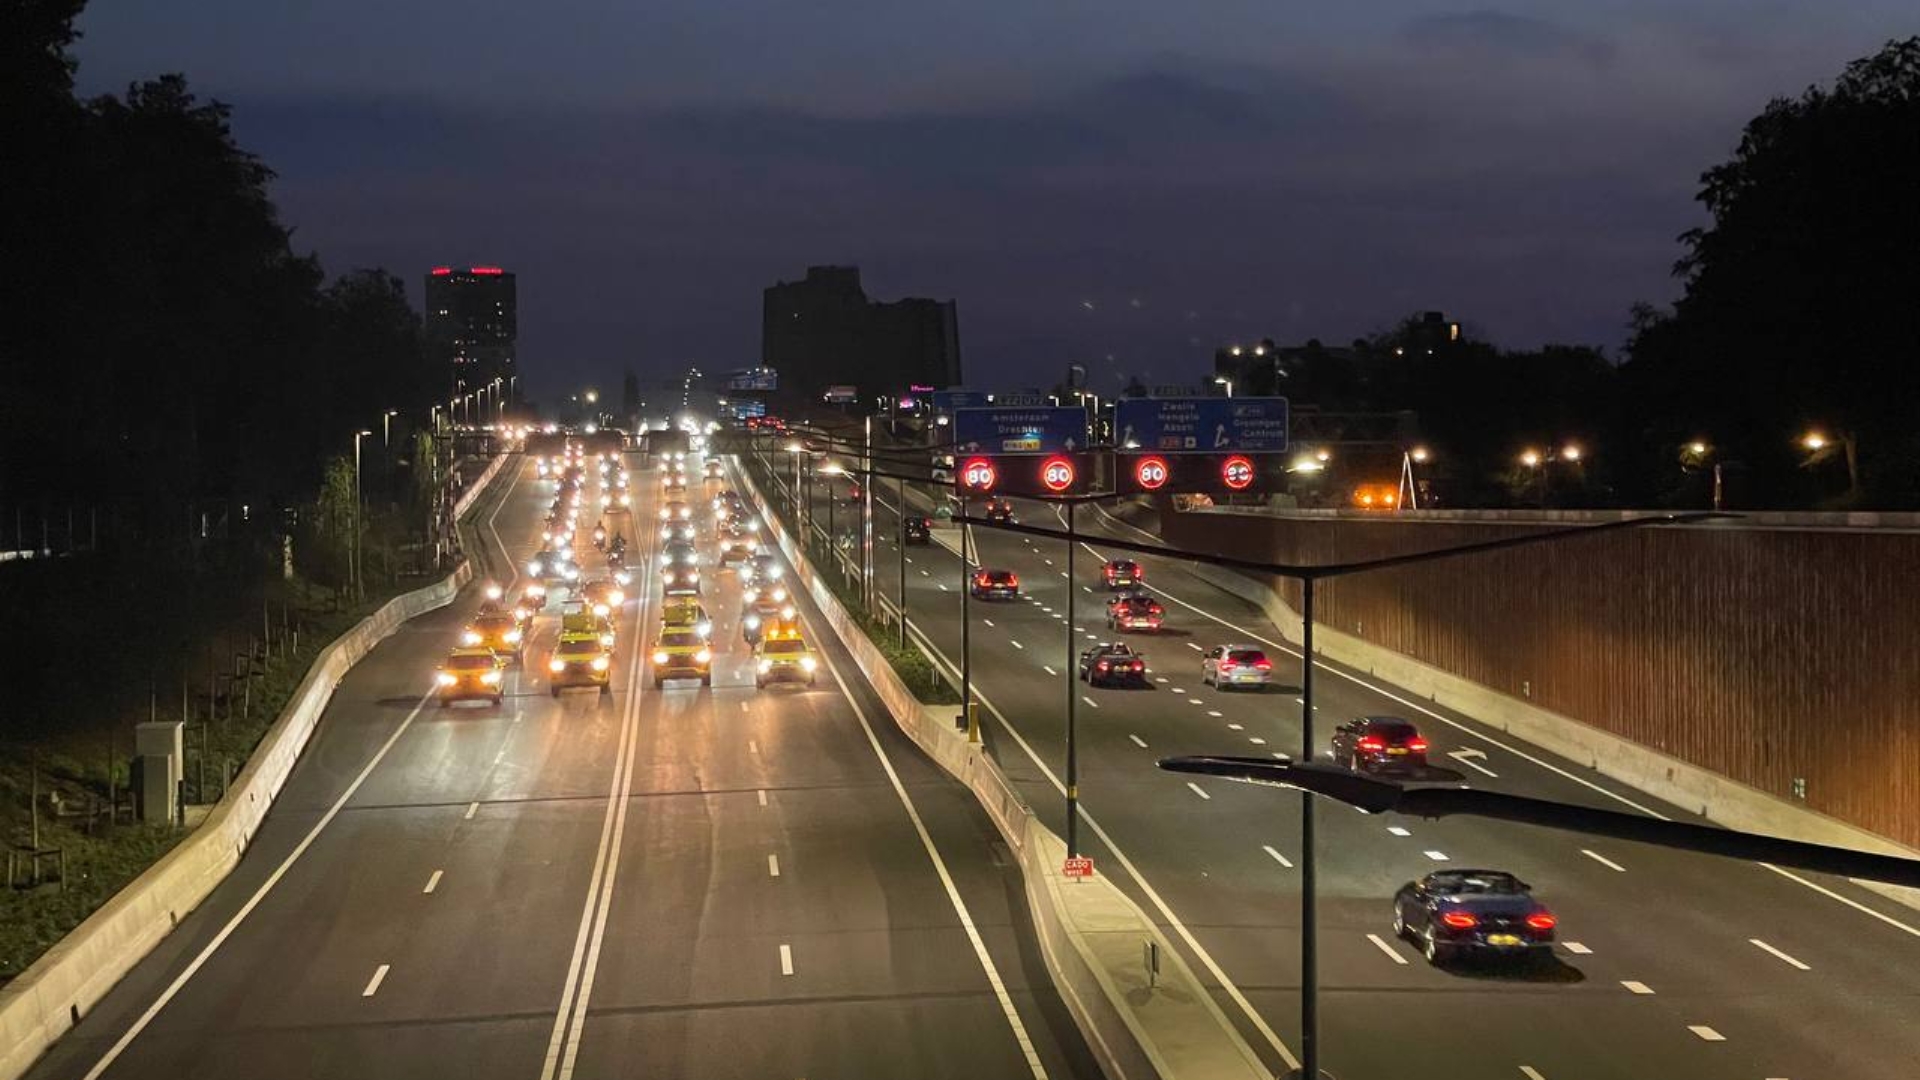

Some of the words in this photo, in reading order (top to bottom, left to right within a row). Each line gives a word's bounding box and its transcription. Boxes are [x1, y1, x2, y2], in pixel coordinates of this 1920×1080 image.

[1162, 401, 1195, 410] Zwolle
[991, 413, 1050, 422] Amsterdam
[1158, 413, 1200, 423] Hengelo
[967, 469, 991, 484] 80
[1047, 468, 1070, 482] 80
[1140, 466, 1163, 481] 80
